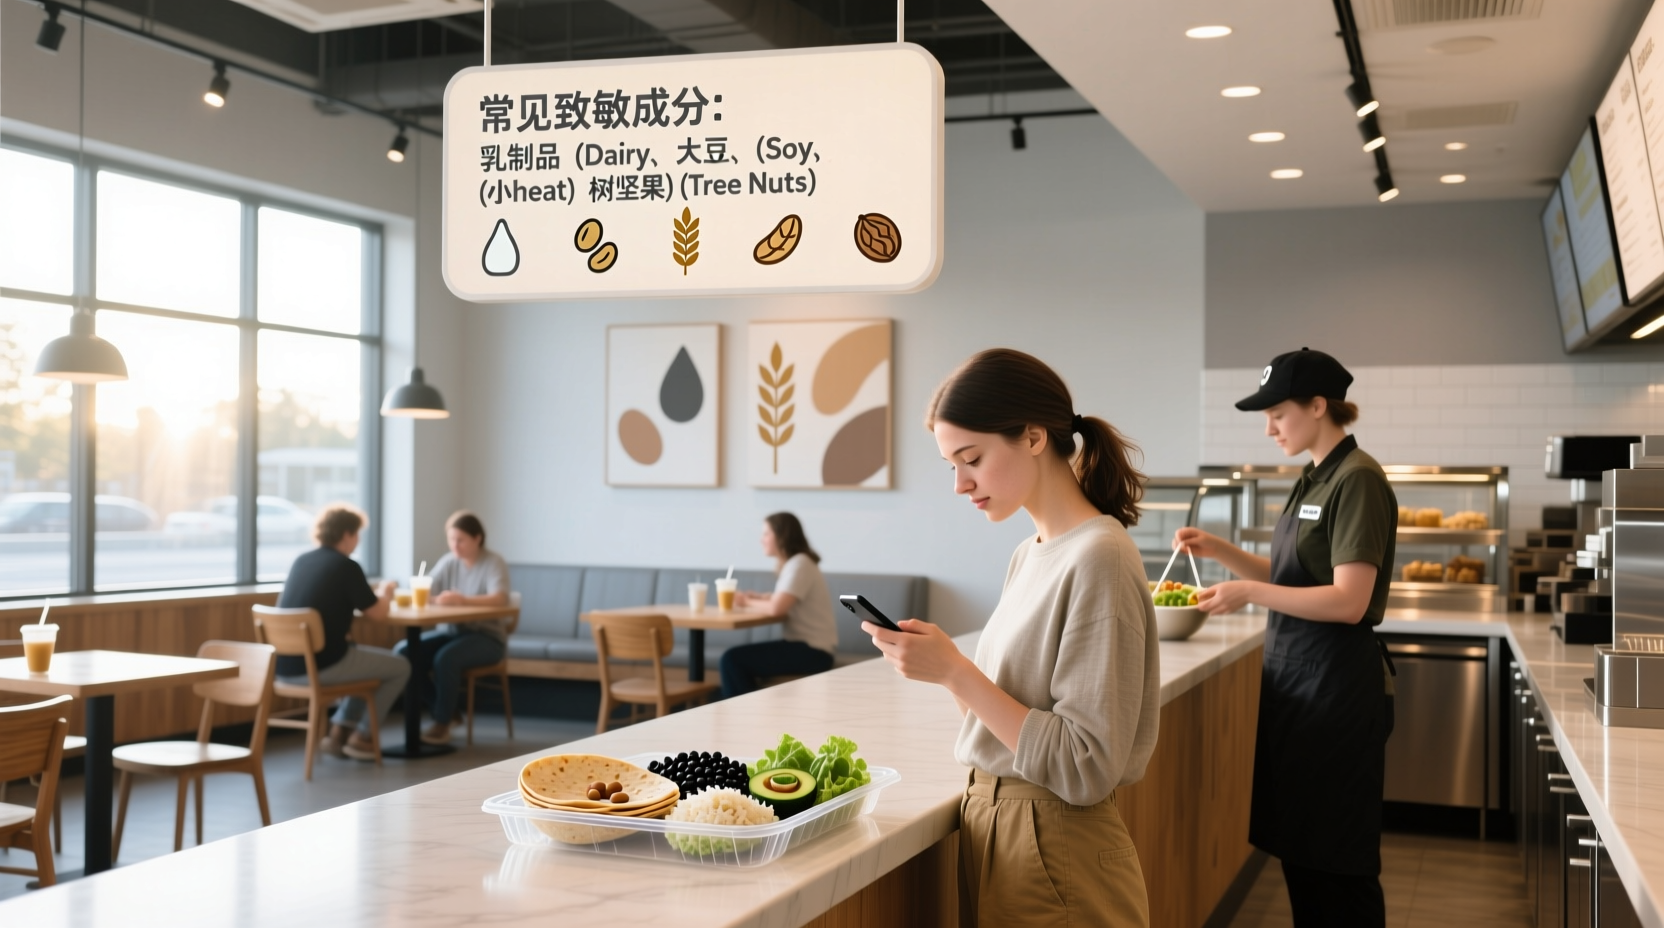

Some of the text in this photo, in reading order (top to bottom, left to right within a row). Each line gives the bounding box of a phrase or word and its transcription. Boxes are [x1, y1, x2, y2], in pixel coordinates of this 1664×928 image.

[480, 142, 560, 172] 乳制品
[680, 172, 742, 201] (Tree
[749, 167, 816, 197] Nuts)
